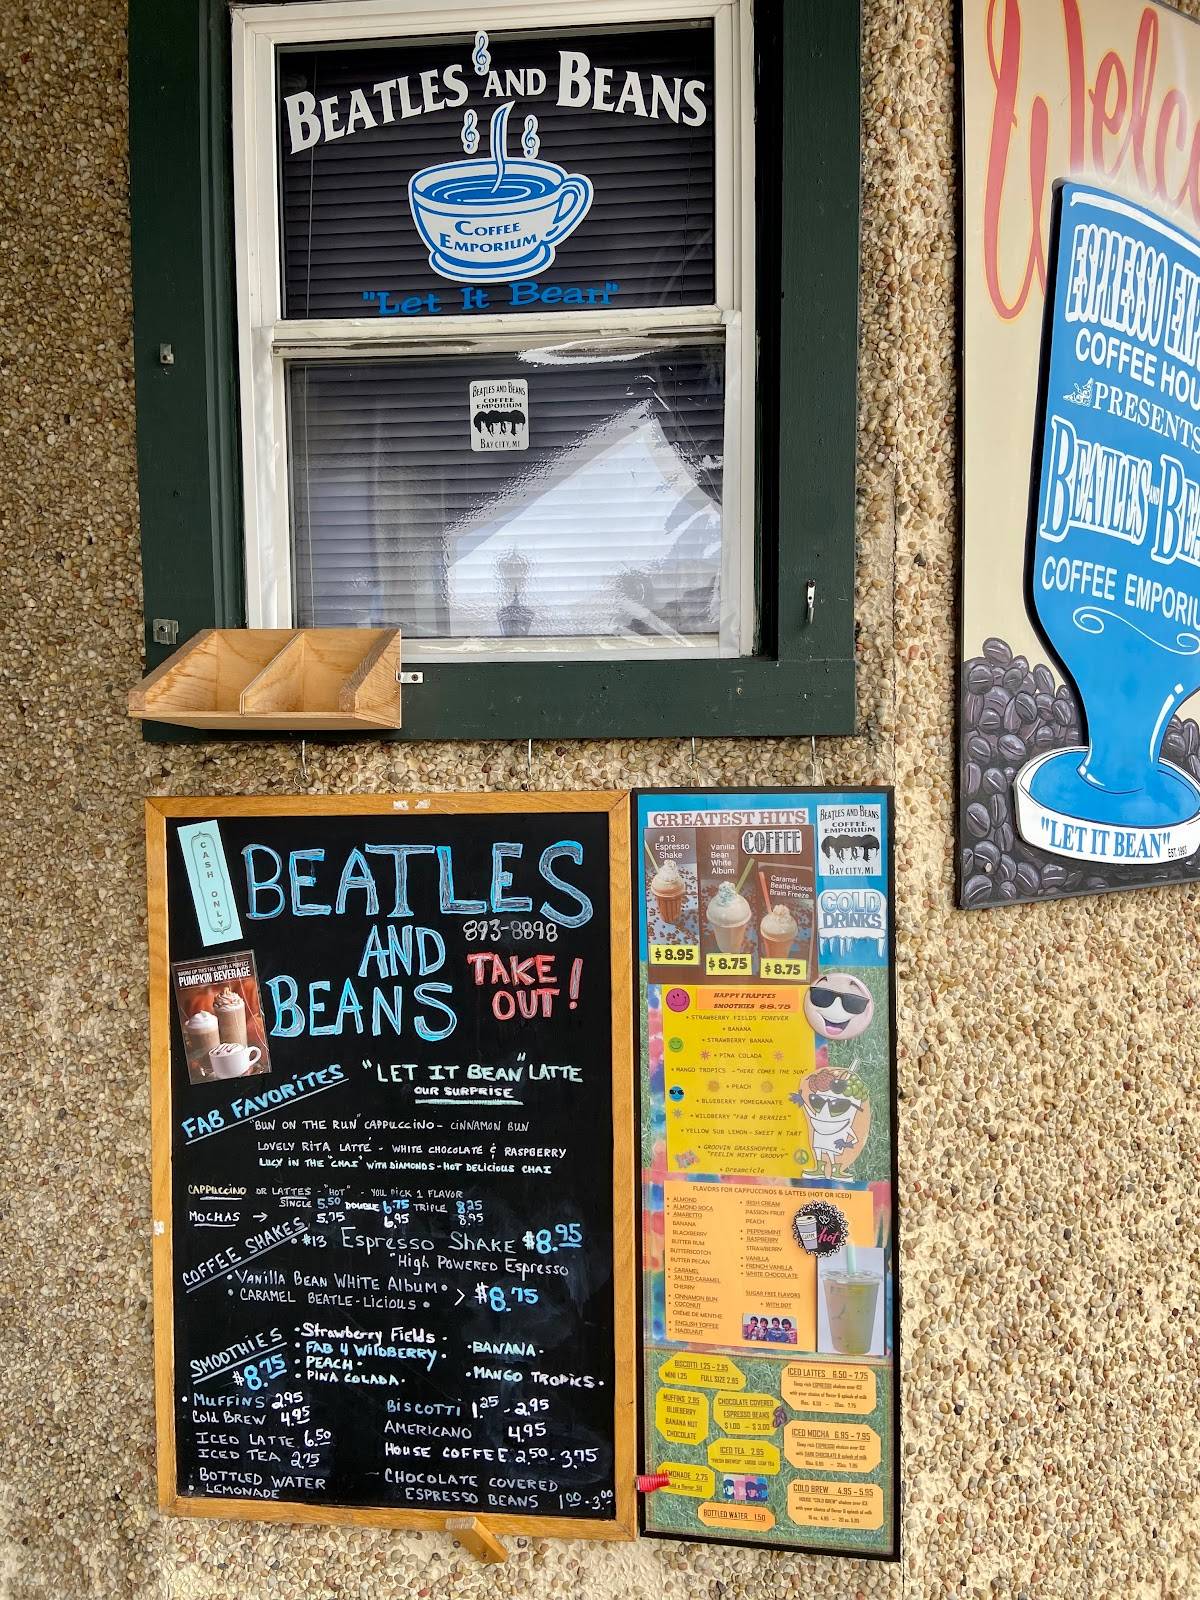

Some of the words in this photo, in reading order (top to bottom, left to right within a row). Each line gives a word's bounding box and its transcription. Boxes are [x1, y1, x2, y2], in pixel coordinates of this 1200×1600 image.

[284, 64, 468, 154] BEATLES
[483, 69, 546, 98] AND
[556, 50, 707, 127] BEANS
[985, 0, 1200, 316] Welc
[455, 220, 521, 237] COFFEE
[440, 232, 537, 253] EMPORIUM
[363, 291, 442, 316] "Let
[460, 286, 490, 311] It
[510, 280, 621, 306] Bean"
[1075, 331, 1158, 392] COFFEE
[473, 385, 495, 398] BEATLES
[496, 385, 507, 394] AND
[508, 382, 526, 396] BEANS
[1092, 382, 1200, 455] PRESENTS
[1040, 415, 1153, 545] BEATLES
[1042, 556, 1117, 601] COFFEE
[653, 811, 755, 826] GREATEST
[758, 810, 806, 825] HITS
[744, 830, 801, 854] COFFEE
[1041, 816, 1087, 853] "LET
[1090, 828, 1110, 856] IT
[1113, 831, 1170, 858] BEAN"
[655, 842, 690, 852] Espresso
[659, 851, 683, 859] Shake
[710, 851, 730, 859] Bean
[200, 841, 214, 878] CASH
[710, 859, 732, 867] White
[711, 867, 735, 875] Album
[770, 874, 798, 883] Caramel
[242, 840, 594, 928] BEATLES
[769, 889, 787, 897] Brain
[787, 891, 809, 899] Freeze
[821, 891, 882, 914] COLD
[211, 891, 224, 927] ONLY
[823, 912, 882, 928] DRINKS
[462, 919, 559, 942] 893-8898
[358, 925, 446, 978] AND
[655, 947, 662, 961] $
[664, 948, 694, 961] 8.95
[467, 952, 557, 986] TAKE
[708, 957, 716, 971] $
[718, 957, 748, 970] 8.75
[764, 962, 771, 975] $
[773, 964, 800, 976] 8.75
[178, 972, 213, 987] PUMPKIN
[213, 966, 252, 983] BEVERAGE
[266, 975, 457, 1042] BEANS
[428, 1064, 461, 1081] IT
[529, 1063, 584, 1083] LATTE
[181, 1109, 225, 1139] FAB
[230, 1063, 345, 1119] FAVORITES
[414, 1086, 440, 1096] OUR
[443, 1086, 515, 1099] SURPRISE
[187, 1183, 247, 1195] CAPPUCCINO
[256, 1187, 268, 1195] OR
[272, 1186, 312, 1195] LATTES
[390, 1187, 412, 1198] PICK
[416, 1189, 424, 1198] 1
[427, 1189, 464, 1199] FLAVOR
[301, 1235, 328, 1248] #13
[340, 1226, 435, 1255] Espresso
[521, 1223, 582, 1255] $8.95
[182, 1246, 243, 1287] COFFEE
[244, 1216, 306, 1254] SHAKES
[474, 1282, 539, 1312] $8.75
[300, 1322, 382, 1346] Strawberry
[390, 1326, 436, 1343] Fields
[190, 1327, 283, 1379] SMOOTHIES
[473, 1340, 536, 1357] BANANA
[306, 1355, 354, 1370] PEACH
[307, 1370, 338, 1383] PINA
[344, 1371, 400, 1386] COLADA
[473, 1365, 524, 1383] MANGO
[787, 1367, 802, 1377] ICED
[803, 1369, 826, 1379] LATTES
[193, 1393, 266, 1408] MUFFINS
[386, 1397, 461, 1417] BISCOTTI
[718, 1398, 749, 1406] CHOCOLATE
[749, 1399, 774, 1407] COVERED
[222, 1410, 267, 1425] BREW
[723, 1410, 751, 1418] ESPRESSO
[752, 1411, 770, 1419] BEANS
[195, 1432, 240, 1445] ICED
[248, 1433, 296, 1448] LATTE
[384, 1419, 473, 1439] AMERICANO
[508, 1421, 547, 1443] 4.95
[666, 1430, 697, 1440] CHOCOLATE
[791, 1428, 806, 1437] ICED
[807, 1429, 830, 1438] MOCHA
[197, 1448, 240, 1459] ICED
[246, 1449, 281, 1461] TEA
[385, 1441, 431, 1458] HOUSE
[442, 1447, 510, 1463] COFFEE
[199, 1467, 263, 1485] BOTTLED
[270, 1475, 327, 1490] WATER
[384, 1467, 479, 1488] CHOCOLATE
[488, 1477, 558, 1492] COVERED
[205, 1484, 280, 1499] LEMONADE
[405, 1487, 480, 1504] ESPRESSO
[487, 1494, 540, 1509] BEANS
[793, 1483, 810, 1492] COLD
[810, 1485, 829, 1494] BREW
[837, 1487, 852, 1496] 4.95
[703, 1508, 728, 1518] BOTTLED
[729, 1511, 748, 1520] WATER
